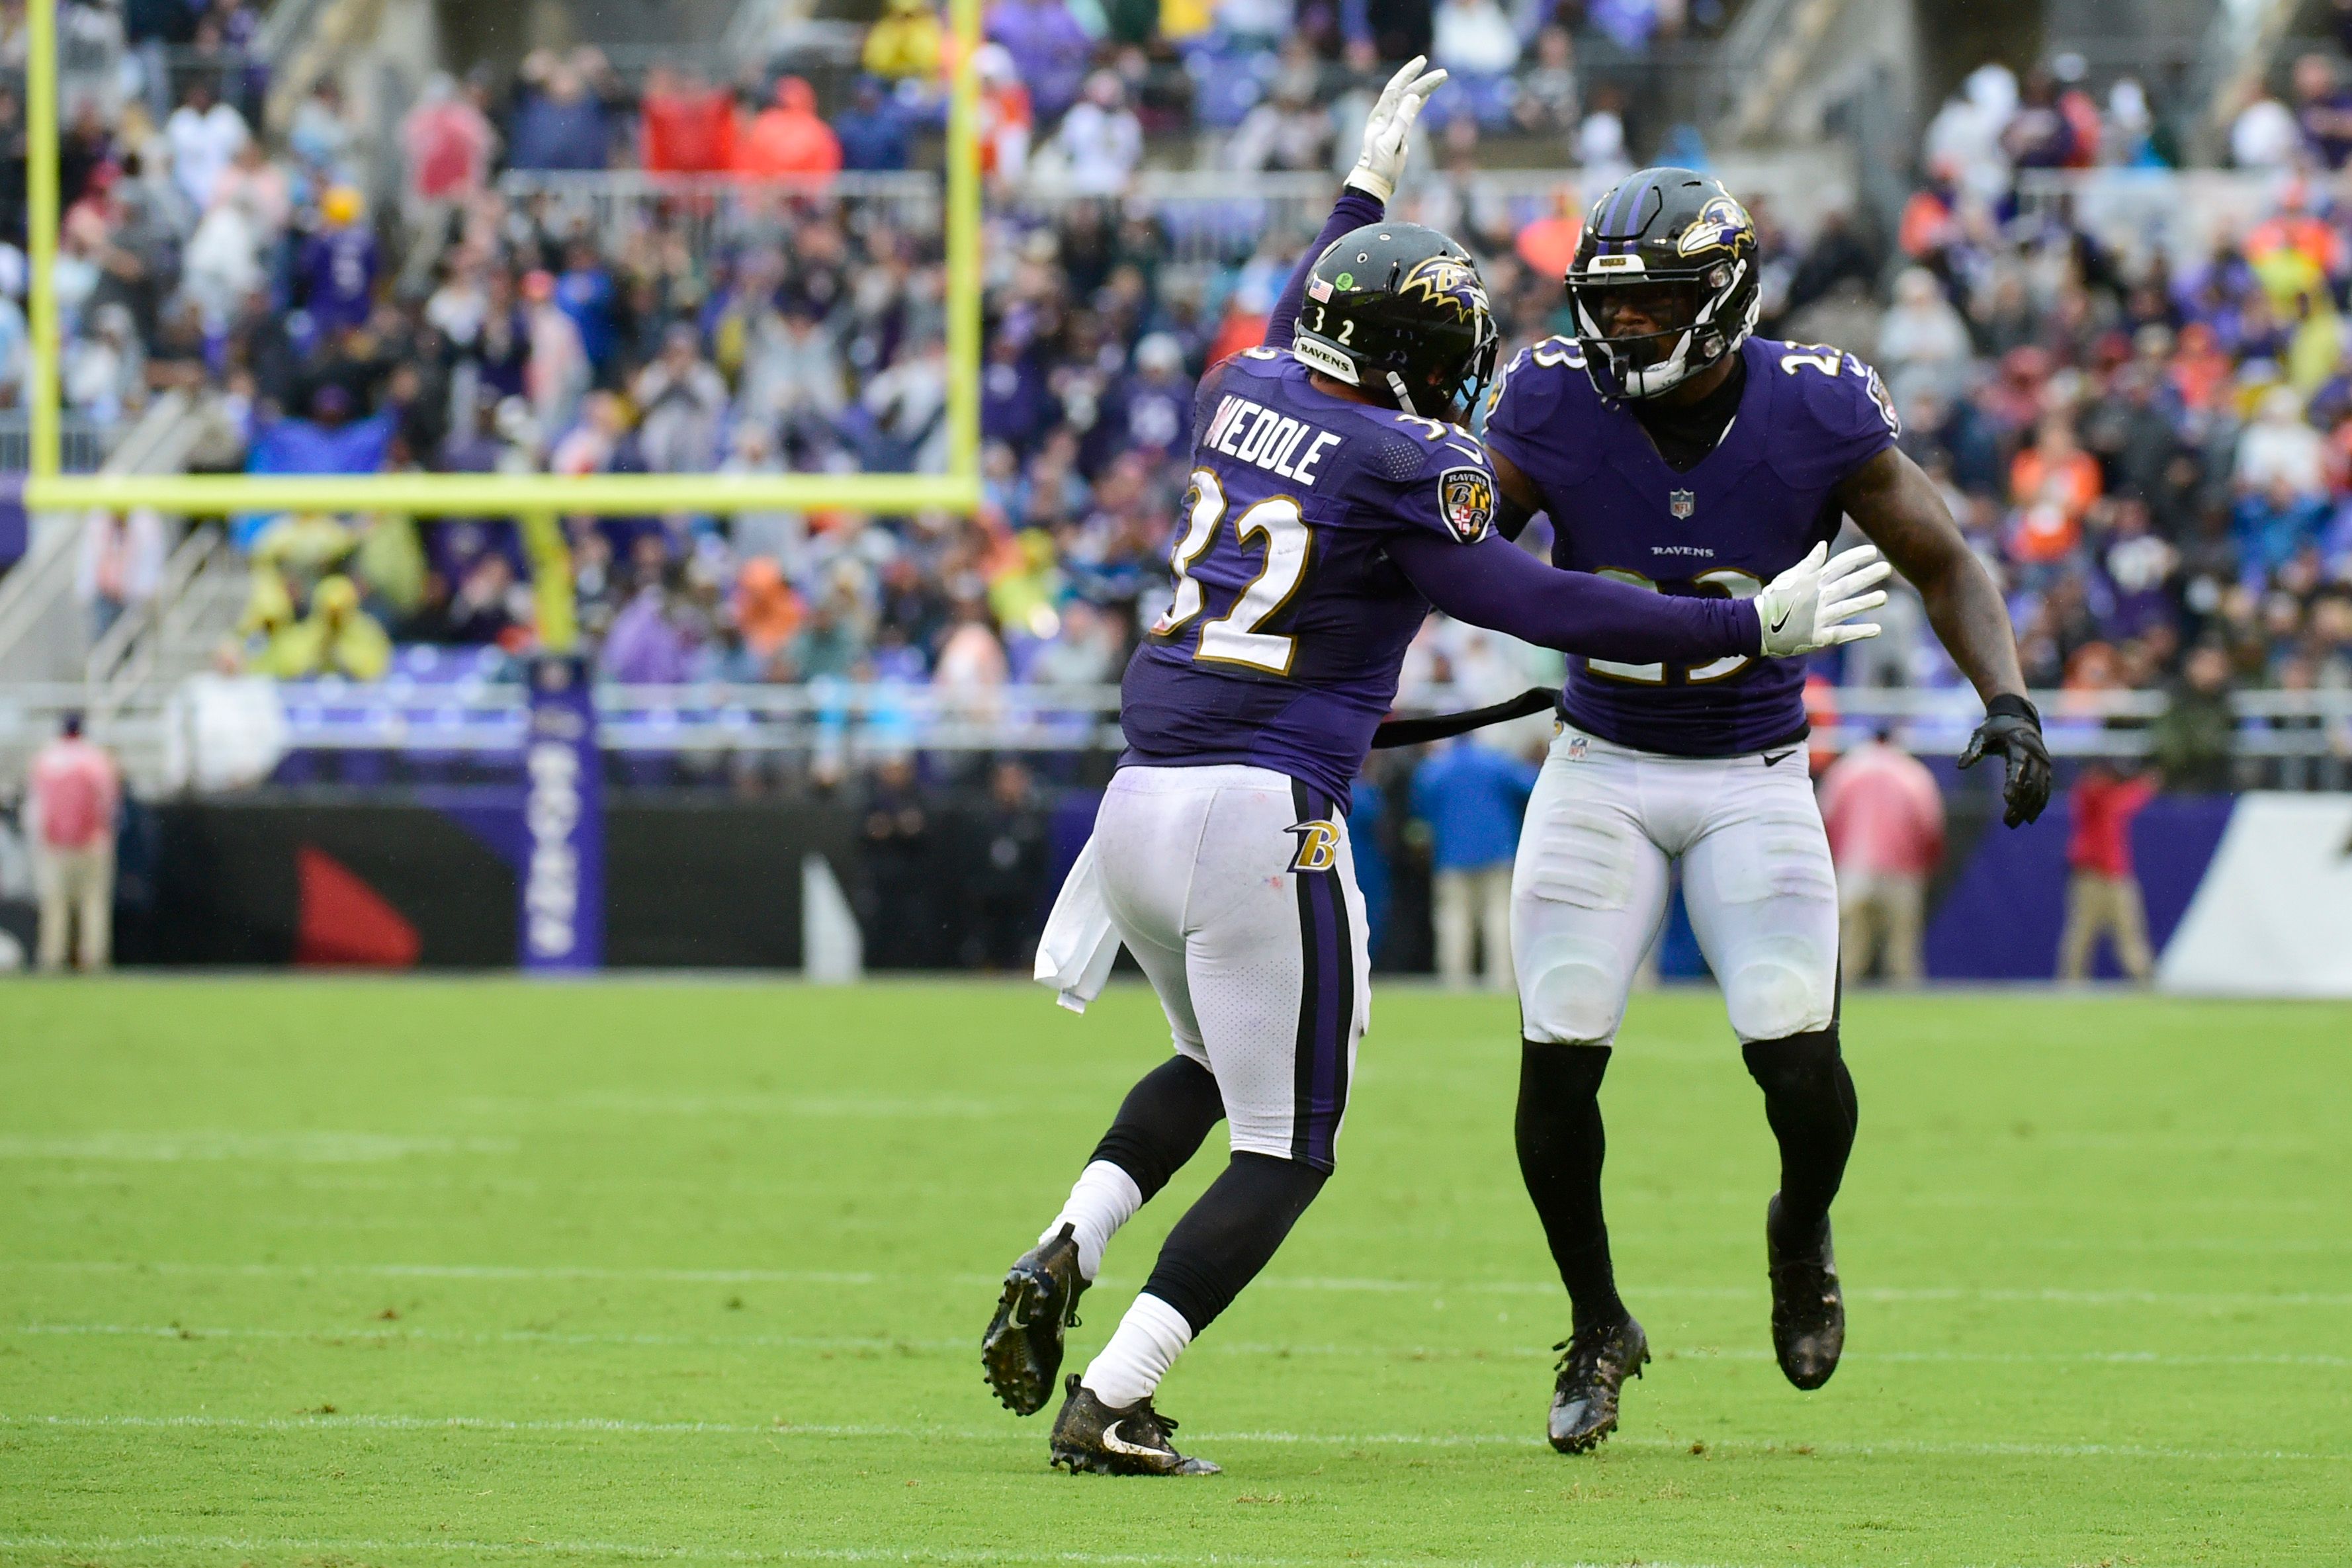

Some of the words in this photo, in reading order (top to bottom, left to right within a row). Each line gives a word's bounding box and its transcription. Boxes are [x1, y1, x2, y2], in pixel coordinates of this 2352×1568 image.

[1300, 343, 1350, 372] RAVENS
[1203, 395, 1342, 486] WEDDLE
[1448, 473, 1488, 487] RAVENS
[1150, 465, 1301, 677] 32
[1650, 545, 1715, 558] RAVENS
[1282, 819, 1341, 873] B
